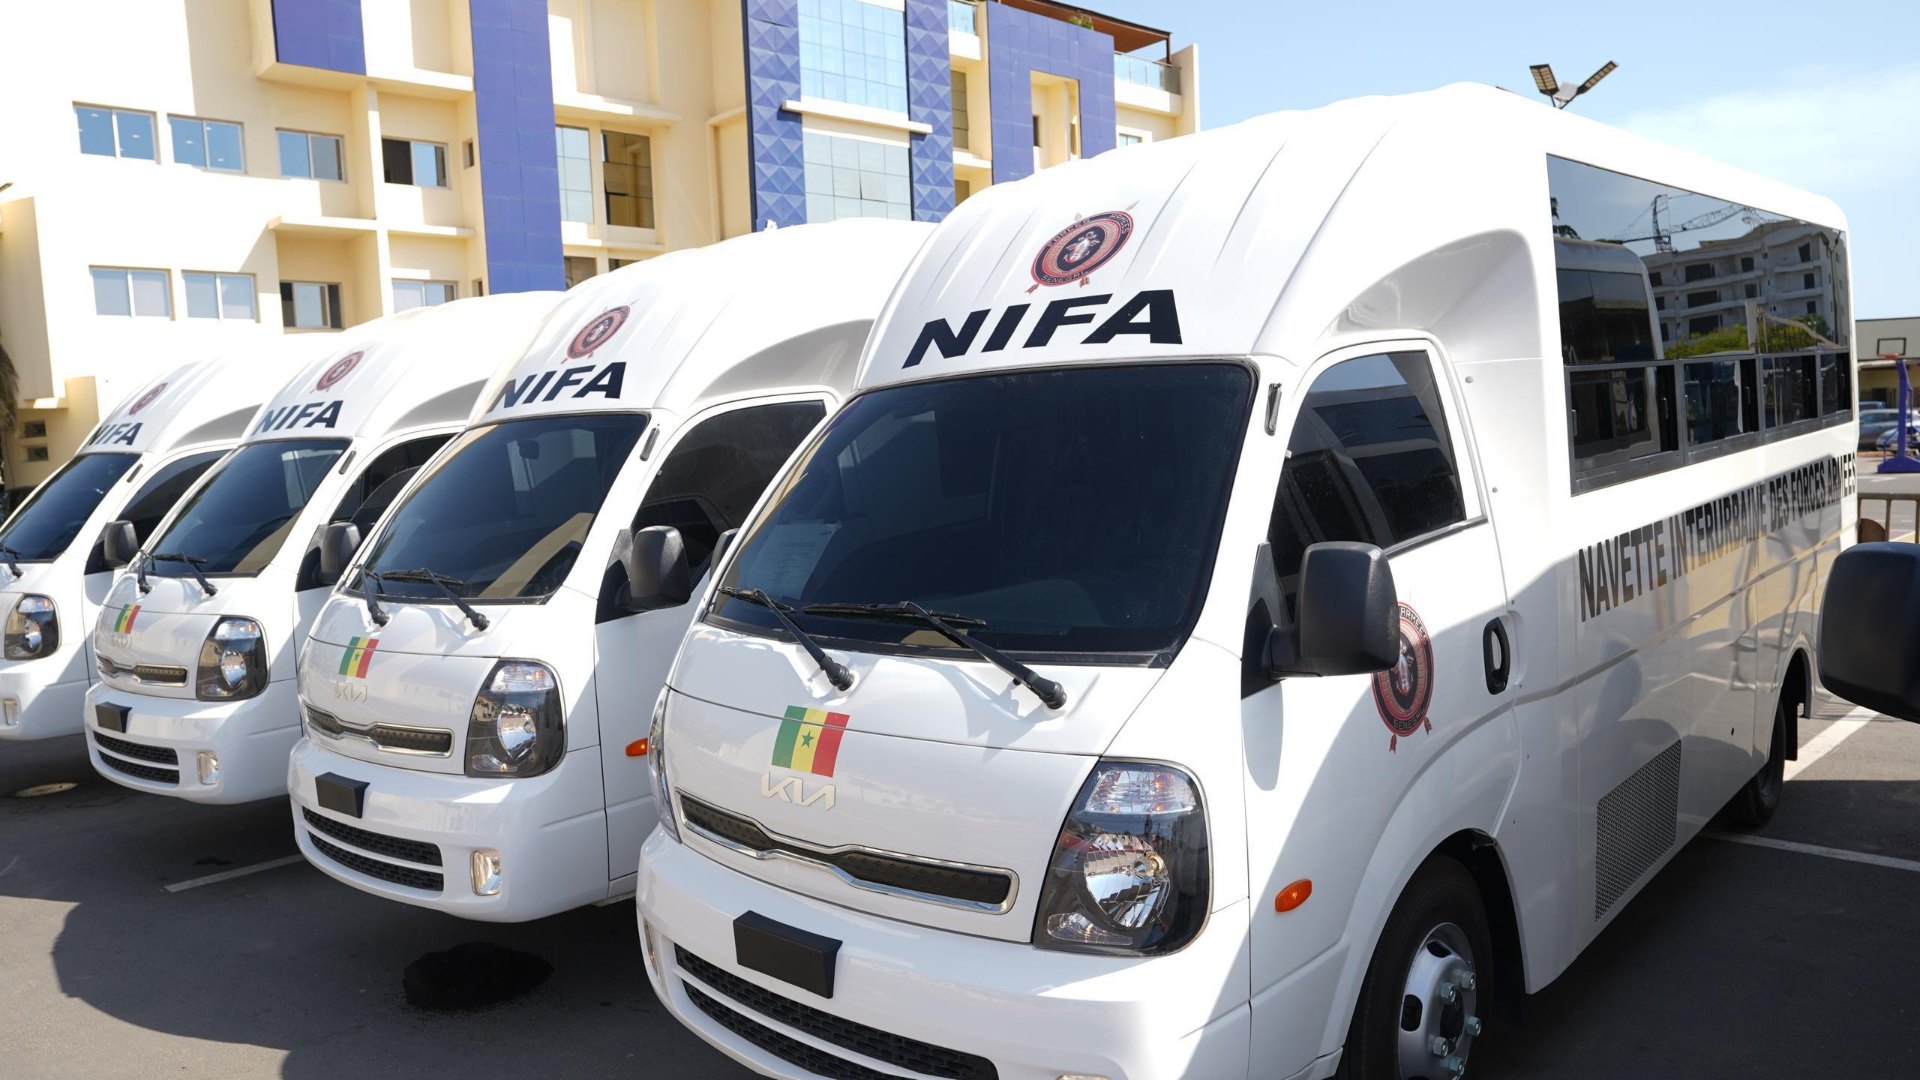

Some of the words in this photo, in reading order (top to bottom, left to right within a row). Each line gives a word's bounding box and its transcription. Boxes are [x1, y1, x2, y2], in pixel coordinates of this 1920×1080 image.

[1109, 213, 1131, 235] ARMEES
[902, 289, 1183, 369] NIFA
[486, 361, 627, 414] NIFA
[251, 400, 344, 437] NIFA
[1579, 520, 1667, 622] NAVETTE
[1669, 483, 1767, 580] INTERURBAINE
[1769, 474, 1789, 533] DES
[1791, 461, 1826, 522] FORCES
[1828, 451, 1856, 505] ARMEES
[761, 771, 837, 812] KIA
